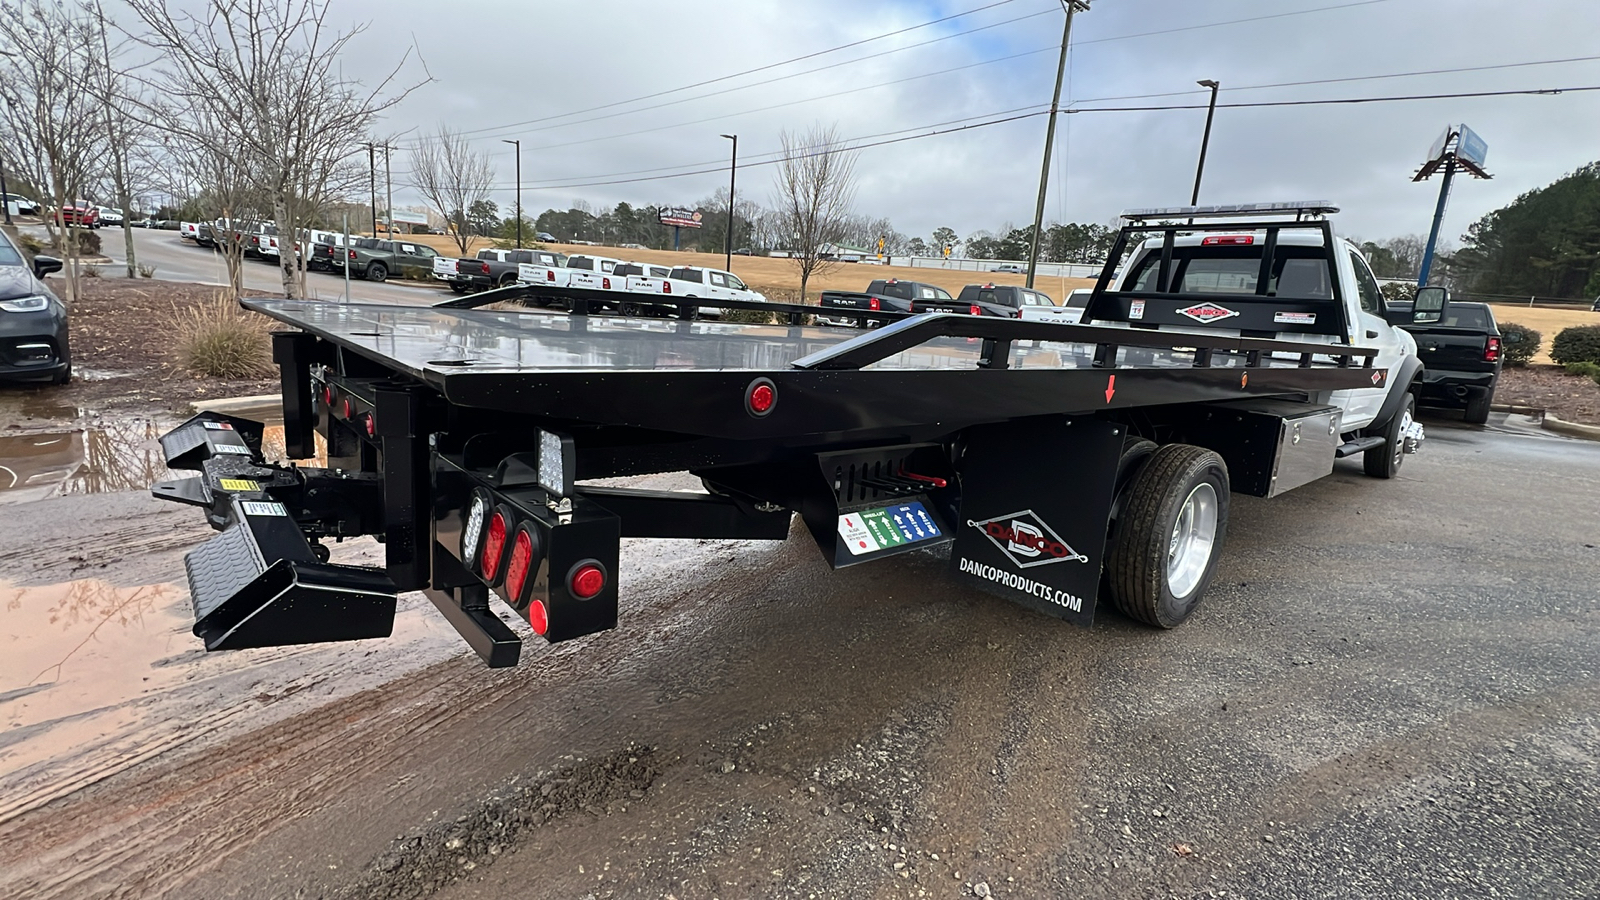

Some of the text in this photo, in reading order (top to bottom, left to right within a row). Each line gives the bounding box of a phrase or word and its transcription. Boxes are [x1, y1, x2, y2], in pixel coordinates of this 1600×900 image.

[1187, 307, 1228, 317] DANCO
[986, 521, 1068, 558] DANCO
[959, 557, 1083, 613] DANCOPRODUCTS.COM
